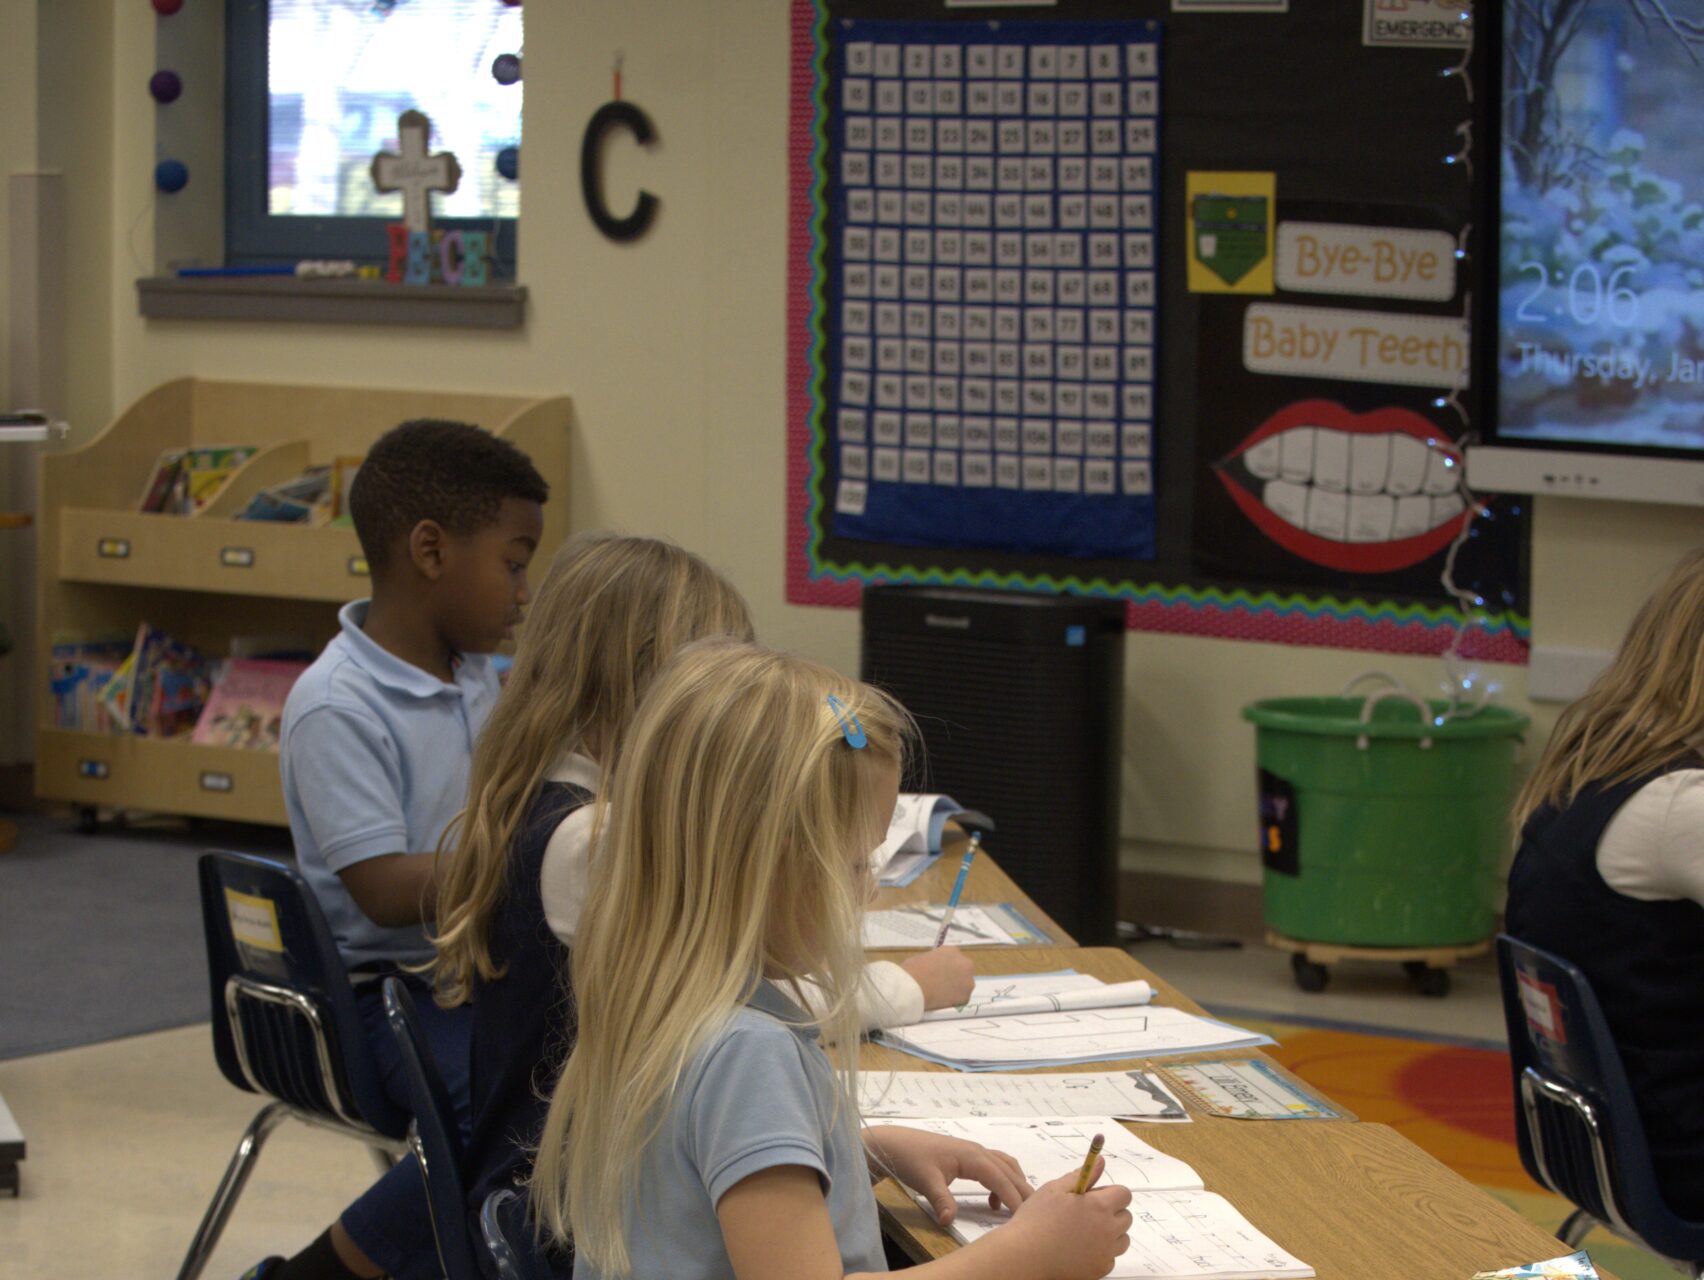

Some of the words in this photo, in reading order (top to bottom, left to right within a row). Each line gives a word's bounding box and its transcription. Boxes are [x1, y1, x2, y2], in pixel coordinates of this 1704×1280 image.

[1376, 19, 1465, 38] EMERGENC
[581, 100, 660, 242] C
[1295, 234, 1440, 284] Bye-Bye
[1515, 260, 1637, 328] 2:06
[1250, 316, 1340, 363] Baby
[1348, 328, 1464, 372] Teeth
[1516, 341, 1658, 389] Thursday,
